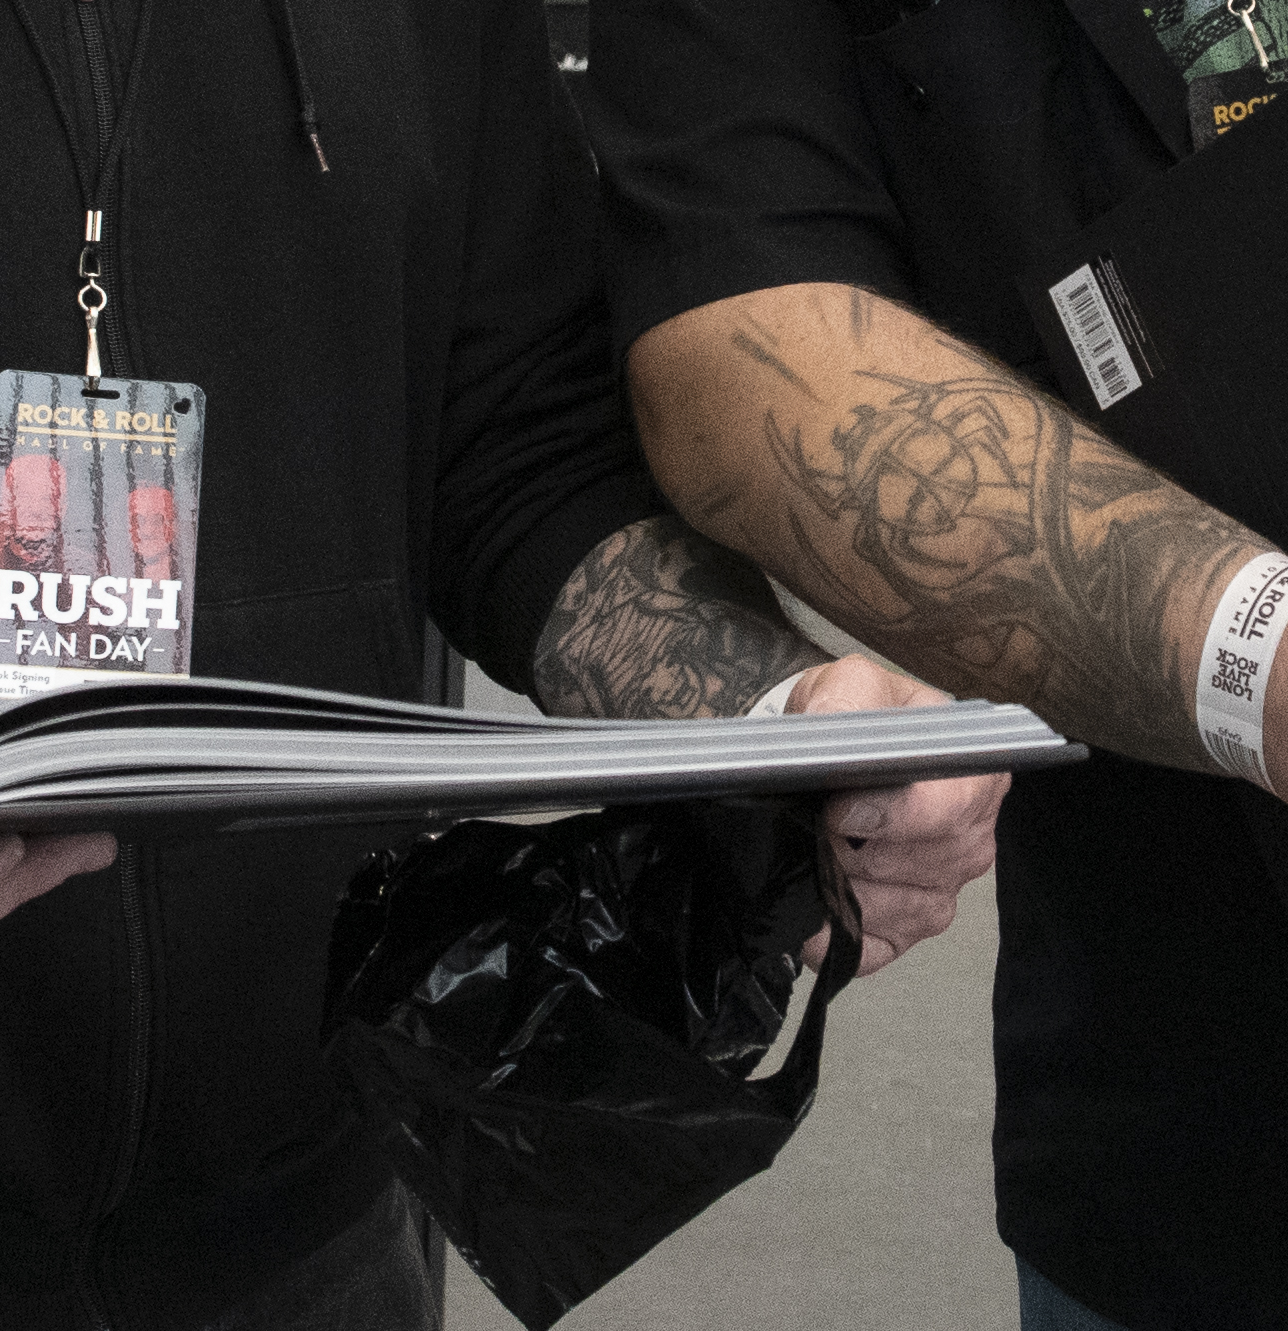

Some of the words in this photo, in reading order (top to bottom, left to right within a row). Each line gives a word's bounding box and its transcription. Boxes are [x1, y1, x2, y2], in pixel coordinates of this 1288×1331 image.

[17, 403, 87, 428] ROCK
[93, 409, 109, 429] &
[115, 411, 177, 433] ROLL
[16, 435, 69, 450] HALL
[83, 441, 107, 452] OF
[121, 443, 176, 457] FAME
[1228, 586, 1257, 636] FAME
[1246, 589, 1285, 641] ROLL
[16, 629, 77, 657] FAN
[89, 633, 153, 662] DAY
[1216, 648, 1259, 676] ROCK
[1218, 663, 1251, 687] LIVE
[12, 671, 51, 685] Signing
[1211, 676, 1254, 702] LONG
